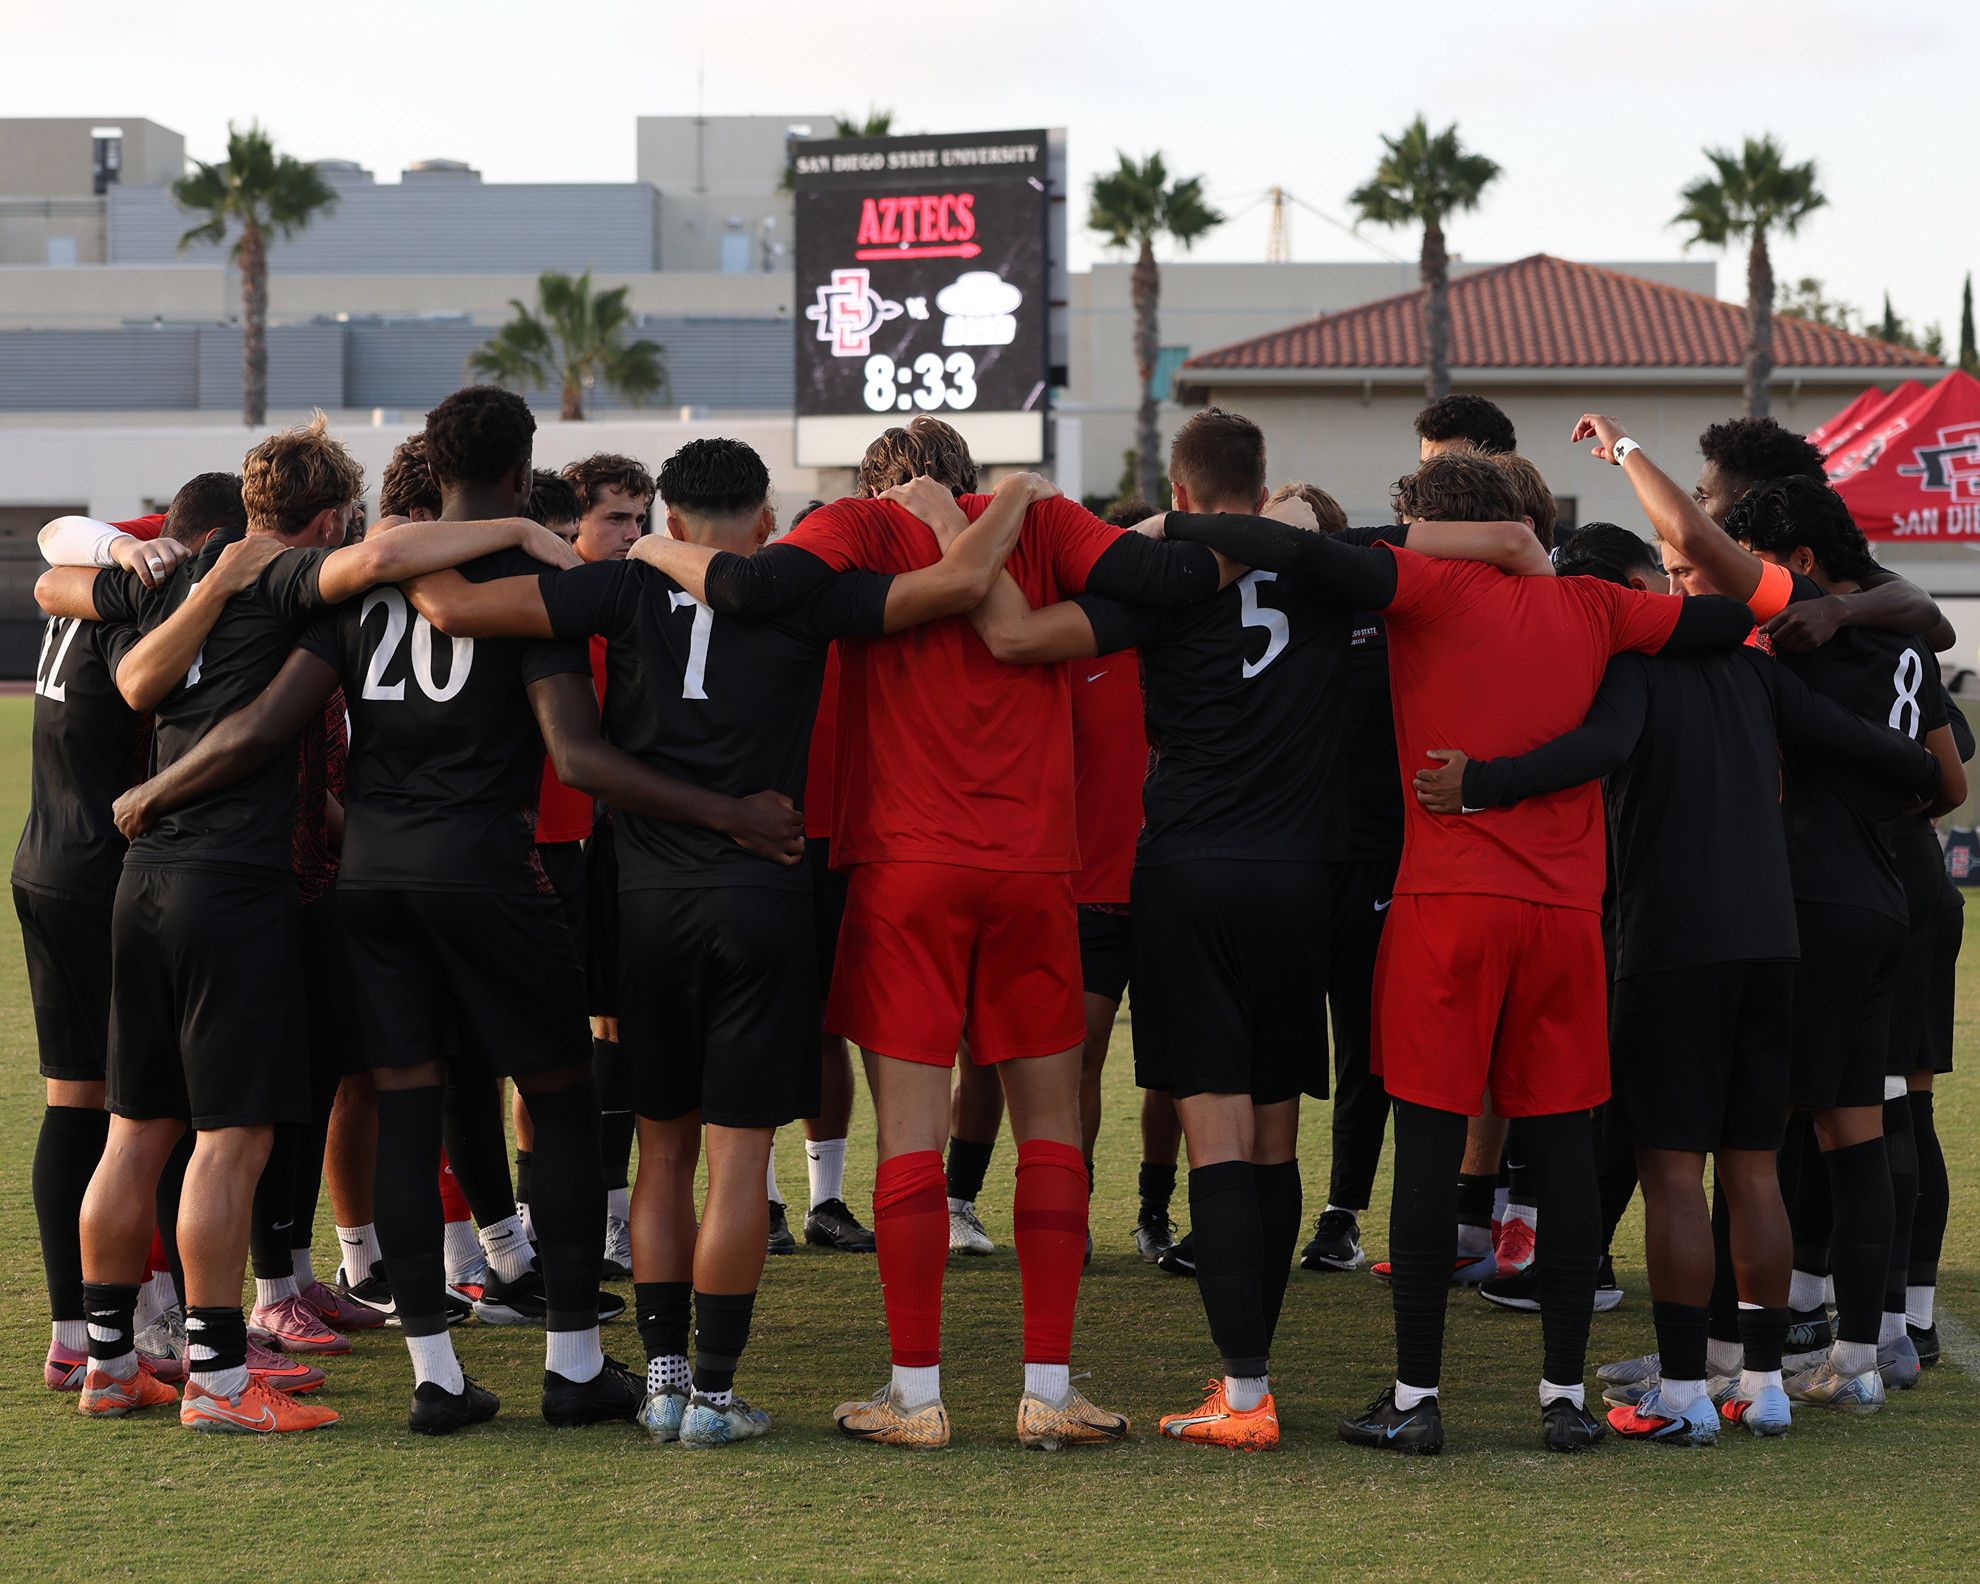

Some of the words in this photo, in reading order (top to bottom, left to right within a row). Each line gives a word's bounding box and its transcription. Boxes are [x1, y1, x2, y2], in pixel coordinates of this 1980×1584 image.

[796, 155, 830, 174] SAN
[832, 152, 885, 172] DIEGO
[887, 151, 938, 169] STATE
[941, 144, 1038, 167] UNIVERSITY
[857, 193, 976, 244] AZTECS
[864, 352, 978, 412] 8:33
[1892, 508, 1939, 536] SAN
[360, 586, 474, 702] 20
[667, 589, 715, 700] 7
[1235, 569, 1290, 679] 5
[1888, 647, 1923, 741] 8
